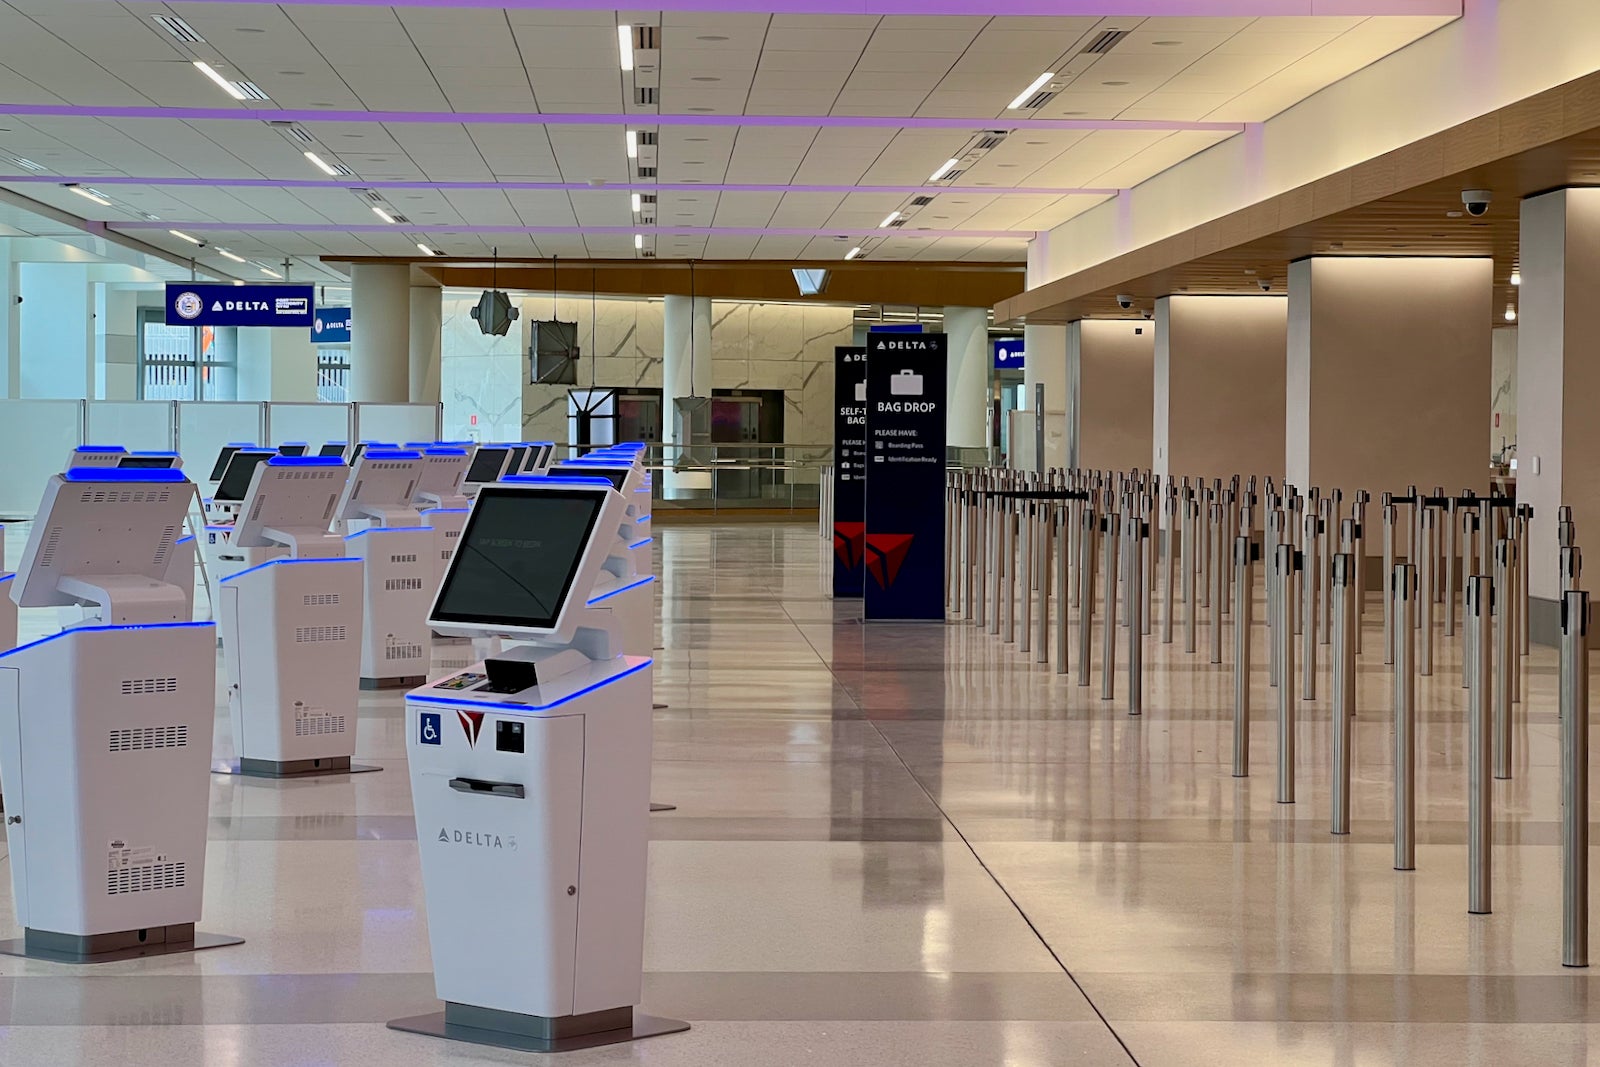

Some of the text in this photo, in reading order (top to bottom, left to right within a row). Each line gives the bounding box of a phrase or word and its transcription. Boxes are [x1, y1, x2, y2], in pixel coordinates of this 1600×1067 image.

[225, 301, 269, 311] DELTA
[888, 341, 926, 350] DELTA
[840, 407, 867, 416] SELF-T
[877, 402, 936, 413] BAG DROP
[847, 416, 865, 424] BAG
[454, 830, 502, 849] DELTA
